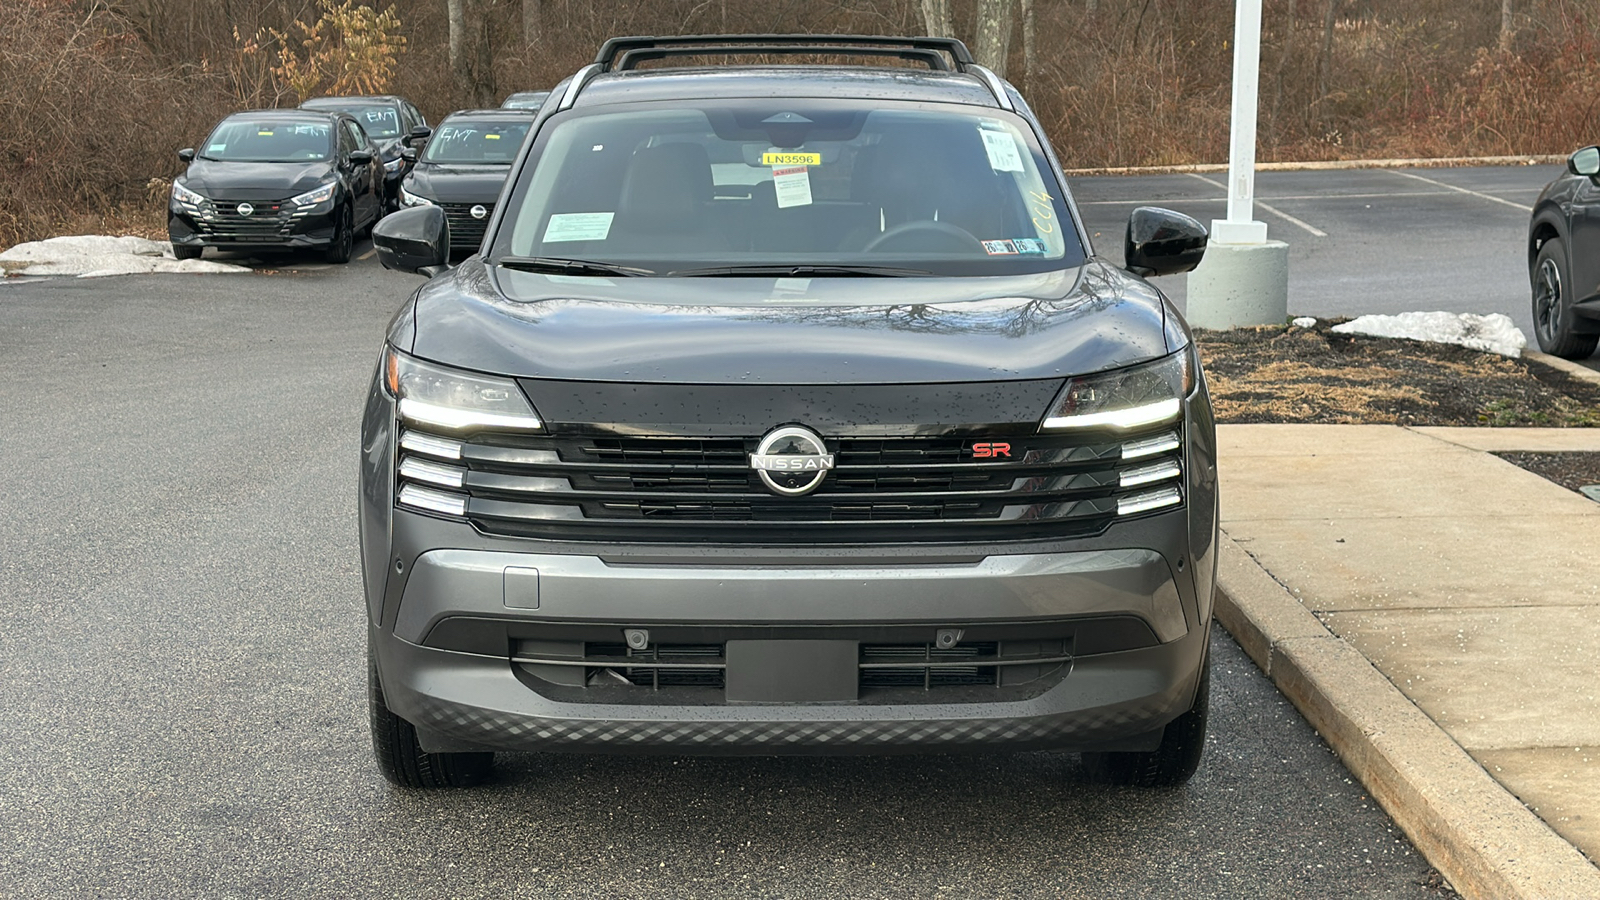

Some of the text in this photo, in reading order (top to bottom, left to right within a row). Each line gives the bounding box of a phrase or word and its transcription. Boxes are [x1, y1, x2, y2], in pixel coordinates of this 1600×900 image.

[767, 155, 814, 164] LN3596
[972, 442, 1012, 457] SR
[754, 457, 832, 469] NISSAN
